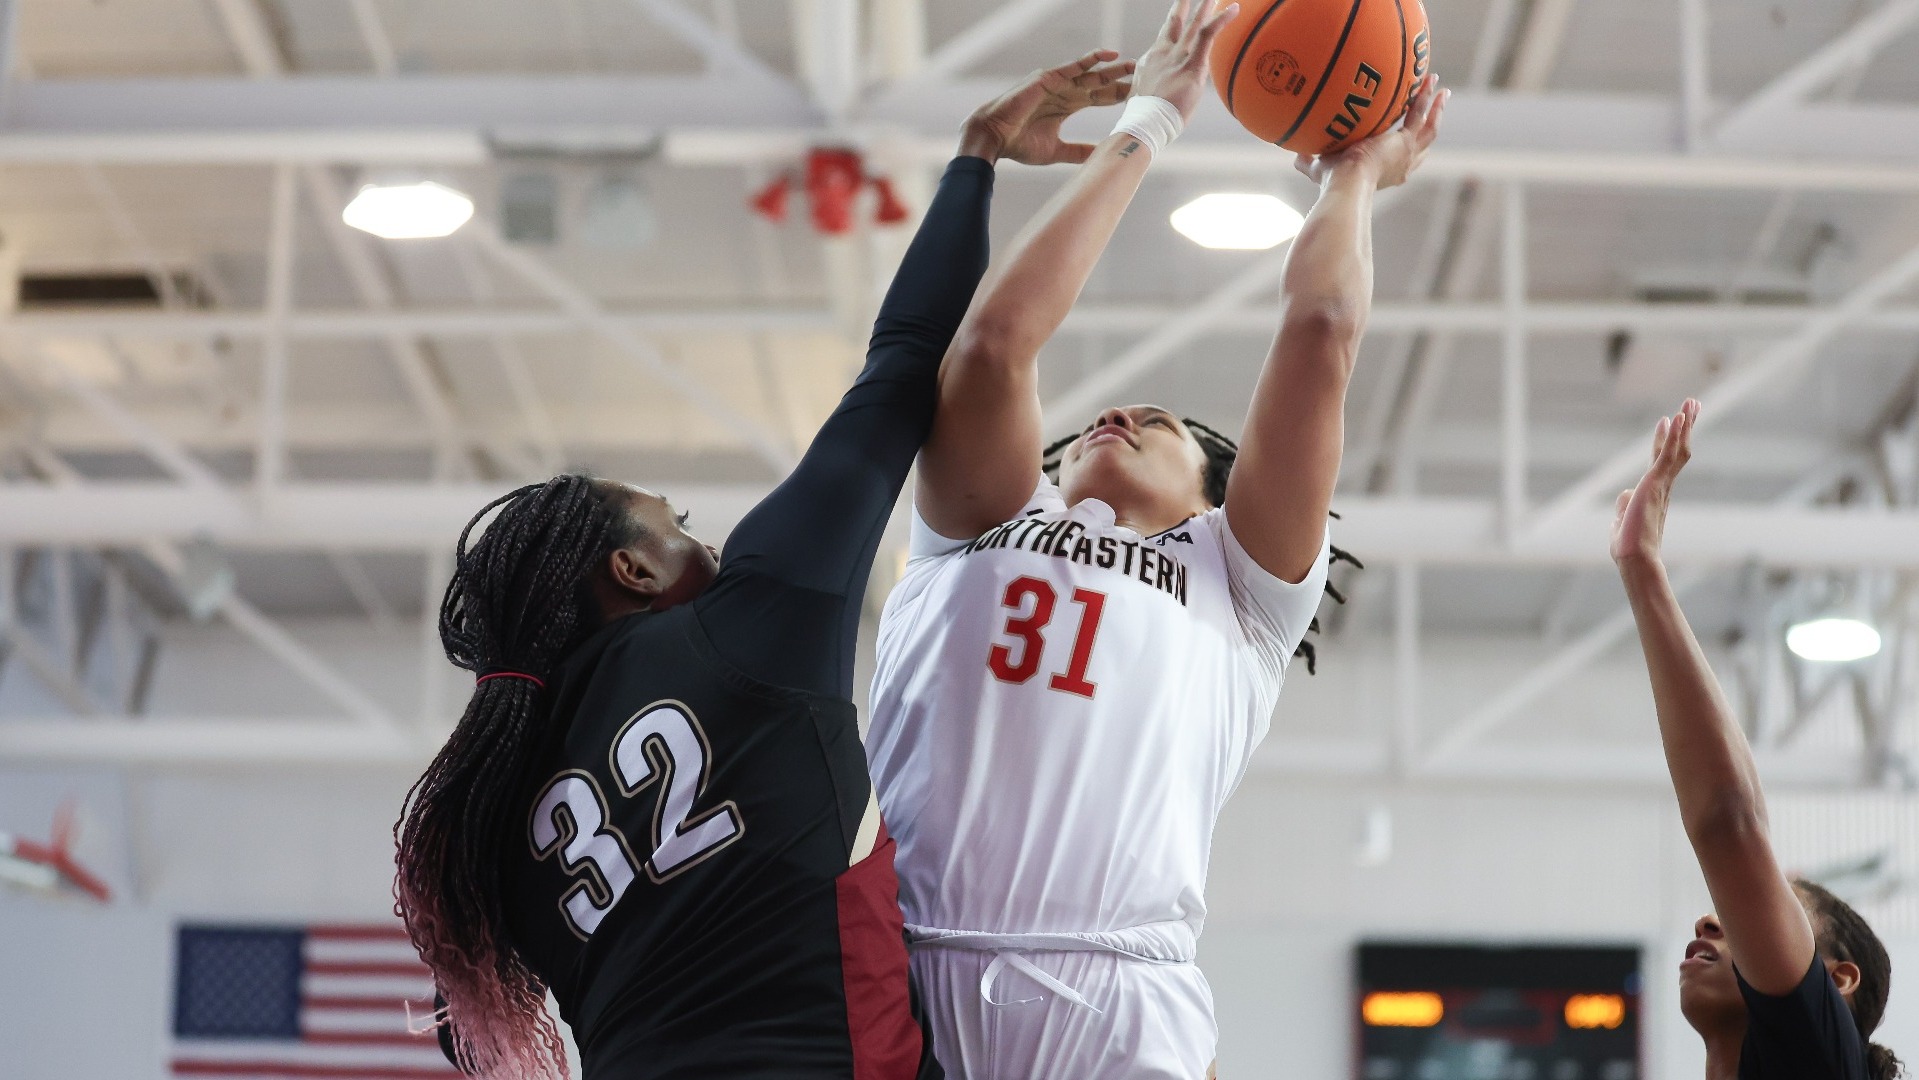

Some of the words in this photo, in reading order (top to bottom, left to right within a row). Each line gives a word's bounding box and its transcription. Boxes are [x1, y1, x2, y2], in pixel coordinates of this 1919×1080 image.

[1325, 61, 1382, 140] EVO
[985, 574, 1109, 700] 31
[527, 698, 745, 942] 32
